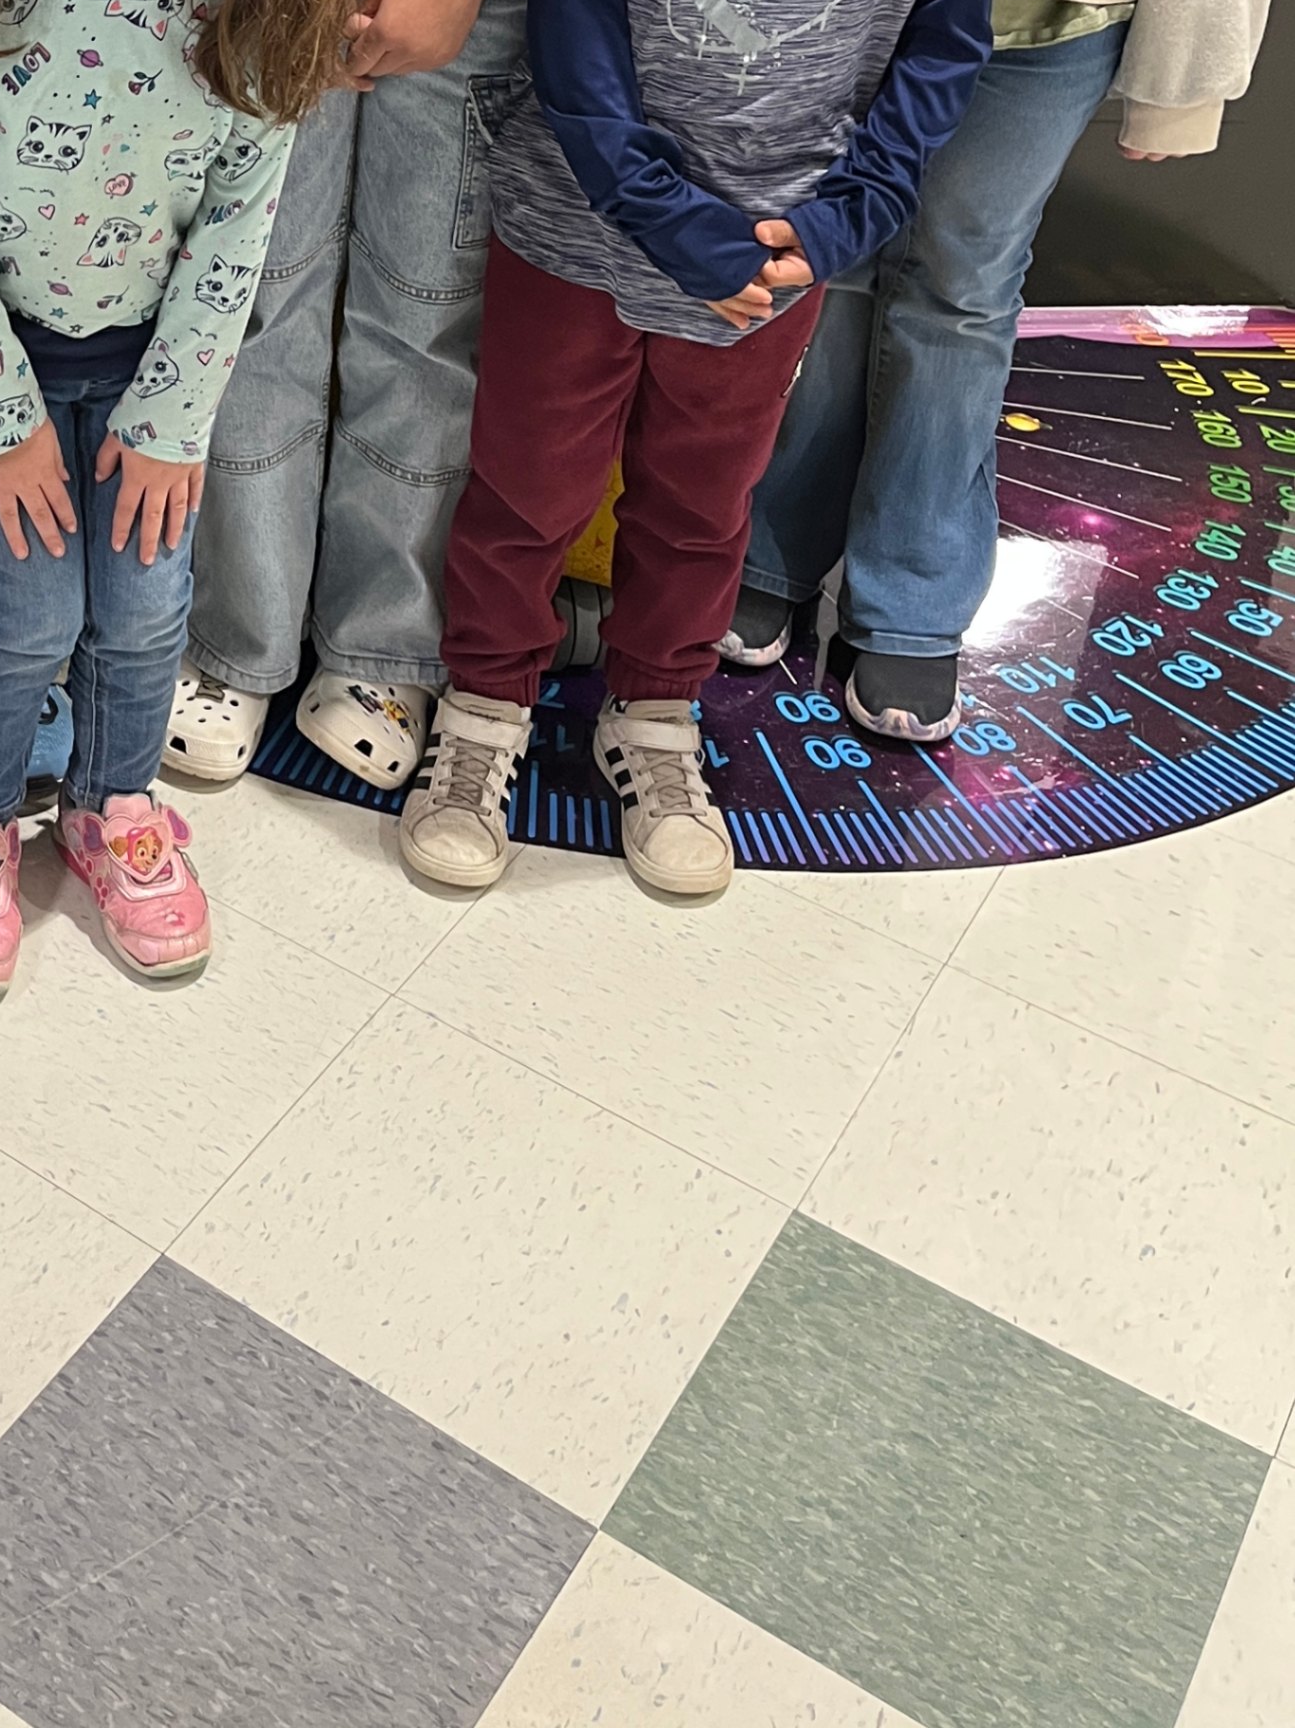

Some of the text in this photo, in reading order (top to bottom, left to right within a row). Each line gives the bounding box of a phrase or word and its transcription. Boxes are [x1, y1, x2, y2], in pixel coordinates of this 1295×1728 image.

[1, 41, 51, 96] LOVE
[1159, 358, 1271, 397] 170 10
[113, 421, 157, 449] LOV
[1192, 410, 1243, 448] 160
[1208, 464, 1253, 504] 150
[1194, 520, 1247, 562] 140
[1155, 568, 1284, 638] 130 50
[1091, 613, 1223, 690] 120 60
[774, 693, 842, 724] 90
[998, 656, 1133, 731] 110 70
[803, 737, 873, 770] 90
[952, 722, 1017, 756] 80
